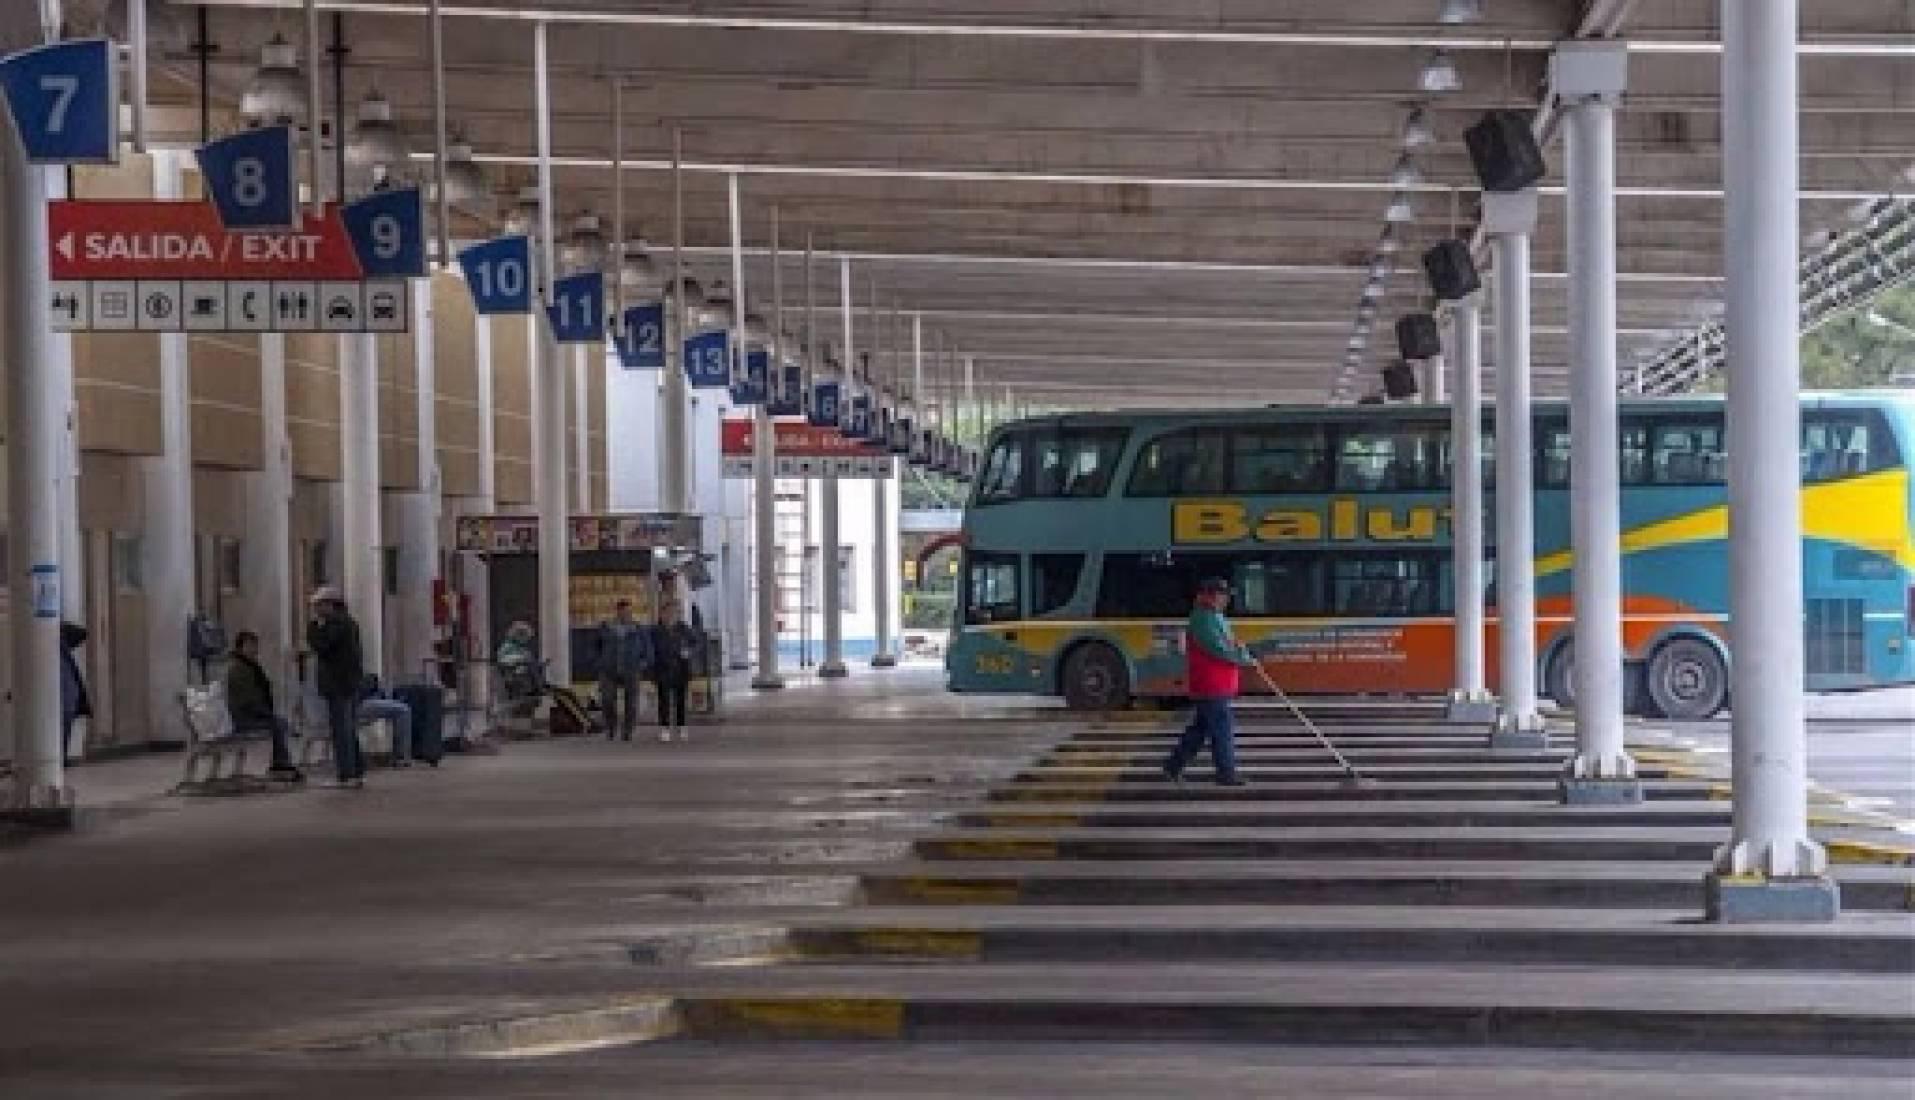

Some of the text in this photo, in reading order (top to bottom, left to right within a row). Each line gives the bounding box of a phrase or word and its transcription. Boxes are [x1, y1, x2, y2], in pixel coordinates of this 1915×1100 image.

[40, 75, 79, 133] 7
[234, 157, 265, 206] 8
[84, 234, 214, 261] SALIDA
[241, 234, 322, 262] EXIT
[369, 215, 399, 258] 9
[477, 260, 521, 297] 10
[558, 291, 592, 327] 11
[626, 323, 659, 354] 12
[690, 345, 724, 376] 13
